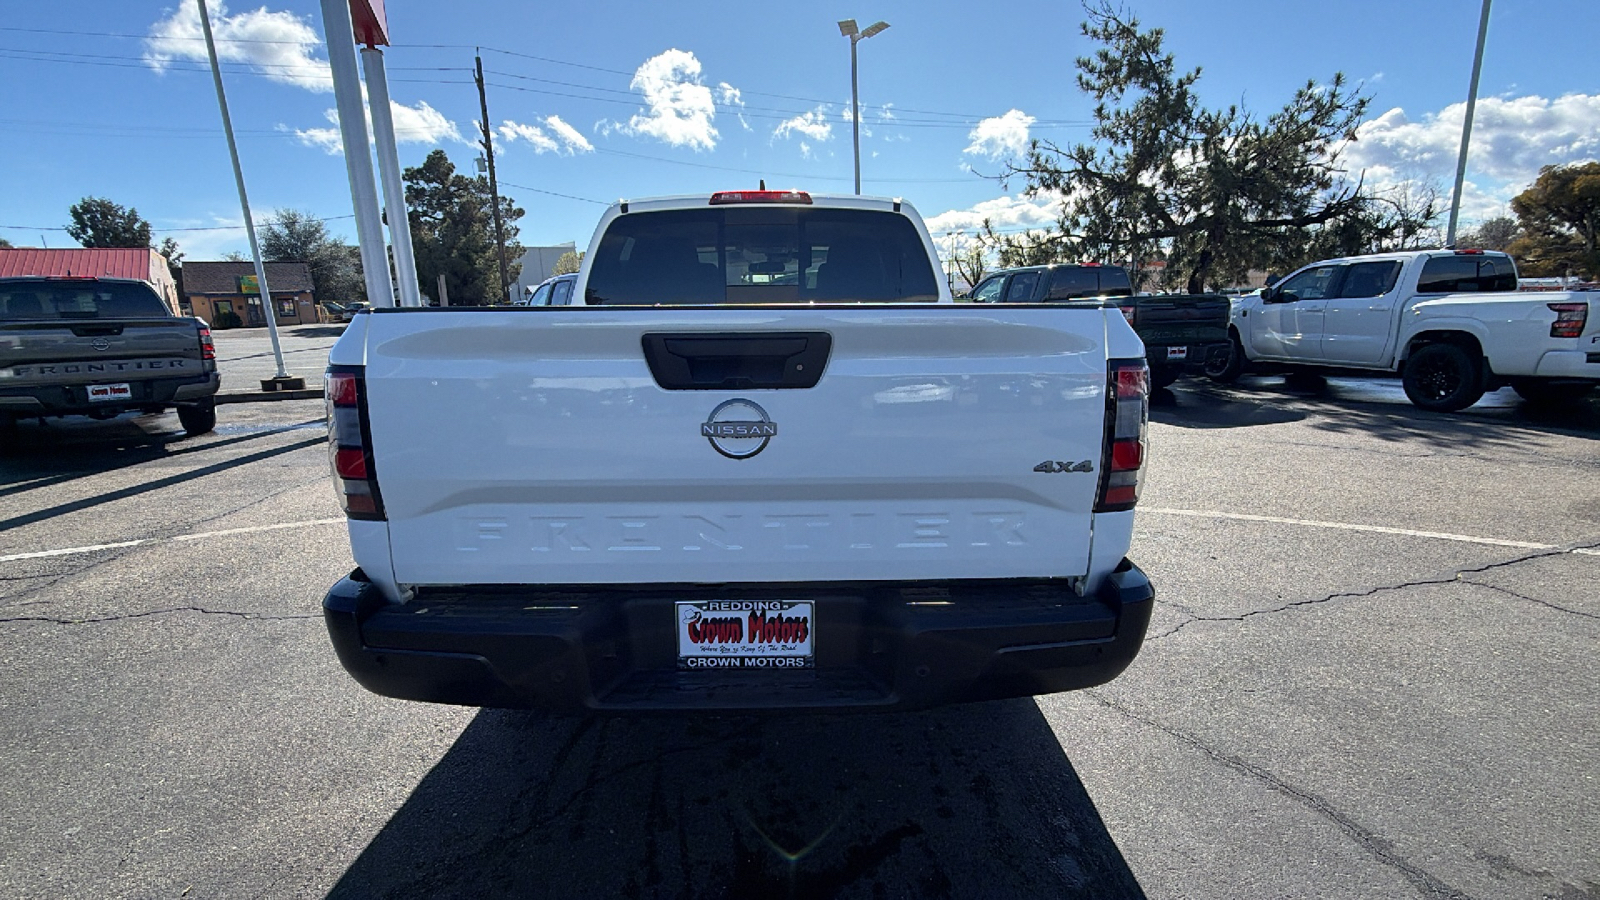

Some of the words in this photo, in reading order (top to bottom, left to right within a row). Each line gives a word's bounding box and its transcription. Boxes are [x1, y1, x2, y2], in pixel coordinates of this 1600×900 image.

[13, 359, 185, 377] FRONTIER
[702, 425, 775, 435] NISSAN
[452, 511, 1028, 553] FRONTIER
[709, 601, 782, 611] REDDING
[687, 613, 744, 645] Crown
[747, 609, 809, 645] Motors
[687, 657, 741, 667] CROWN
[744, 657, 805, 667] MOTORS
